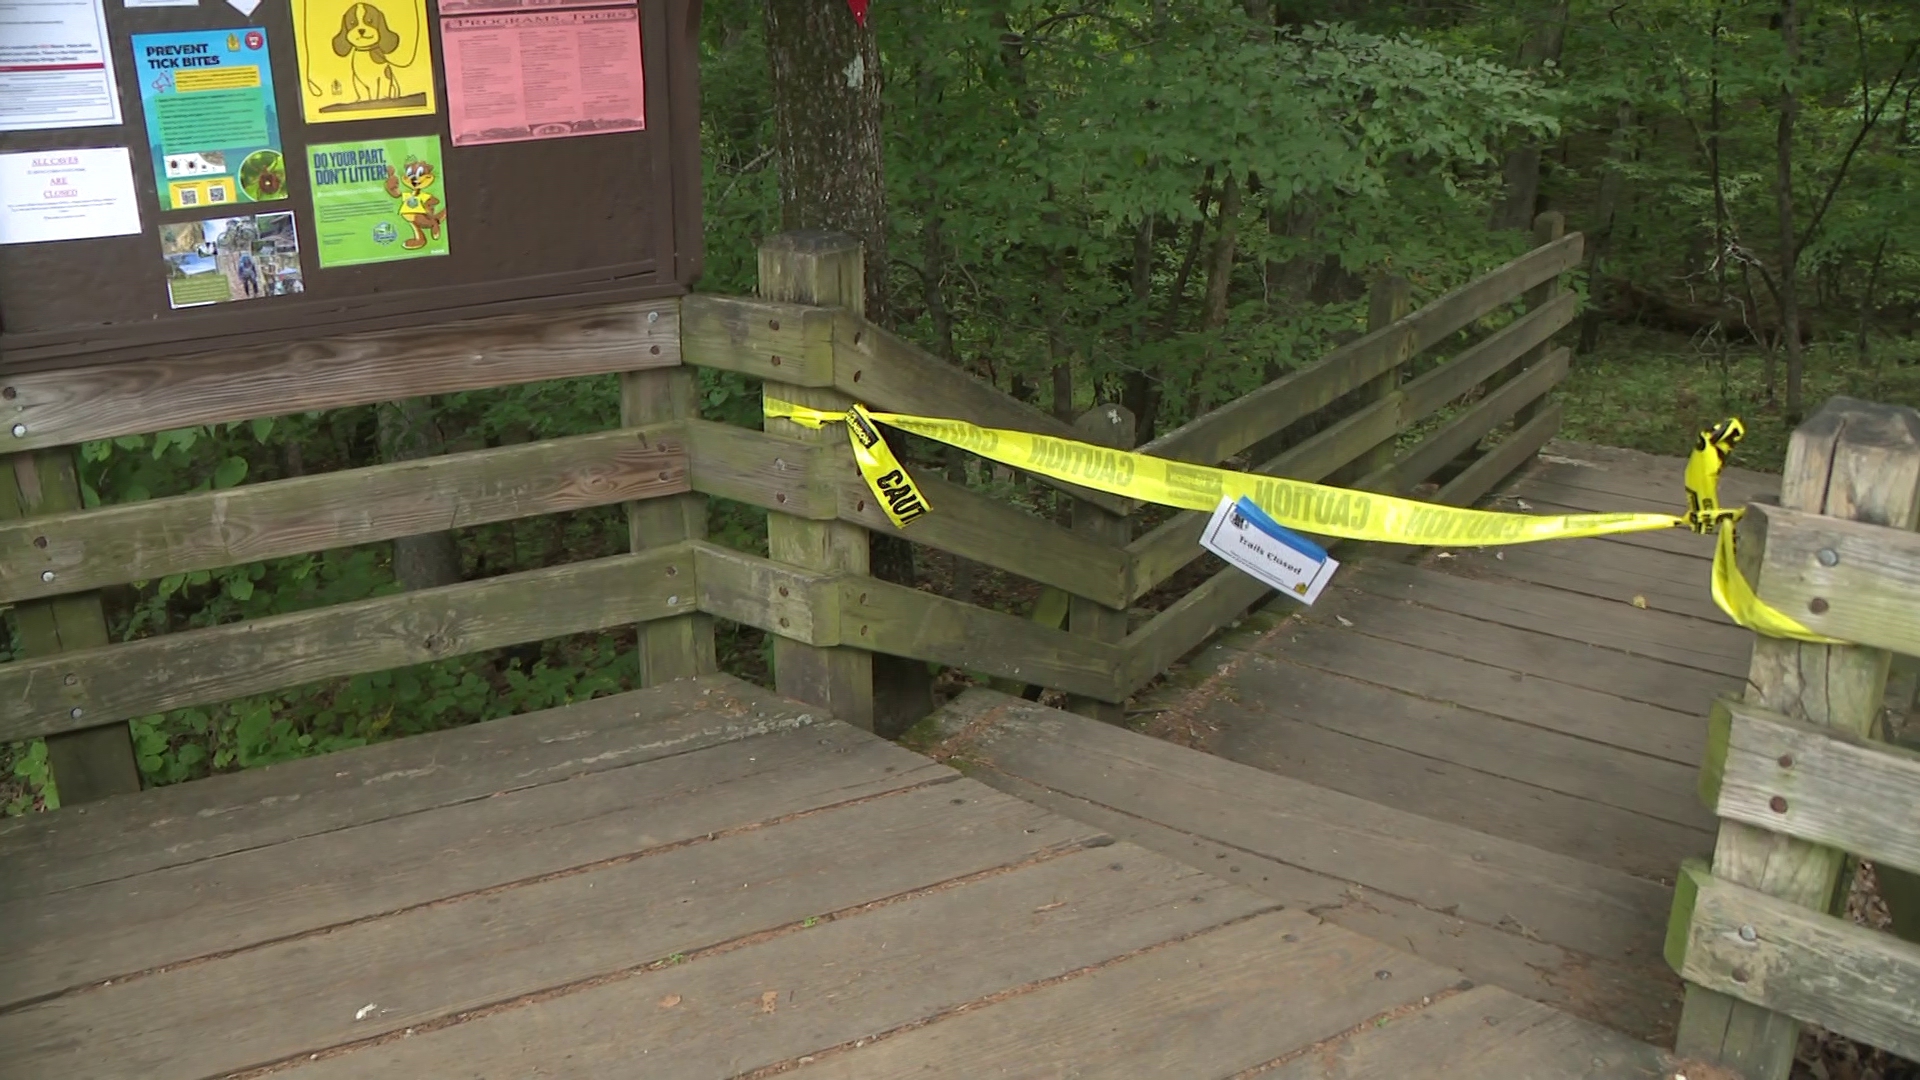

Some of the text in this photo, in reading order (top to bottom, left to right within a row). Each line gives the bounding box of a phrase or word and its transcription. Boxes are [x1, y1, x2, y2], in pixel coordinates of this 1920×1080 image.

[146, 43, 209, 57] PREVENT
[148, 55, 220, 69] TICK BITES
[32, 158, 50, 167] ALL
[313, 152, 328, 169] DO
[329, 150, 357, 168] YOUR
[50, 177, 69, 186] ARE
[315, 164, 387, 186] DON'T LITTER!
[43, 189, 78, 198] CLOSED
[1239, 534, 1265, 556] Trails
[1267, 551, 1302, 575] Closed
